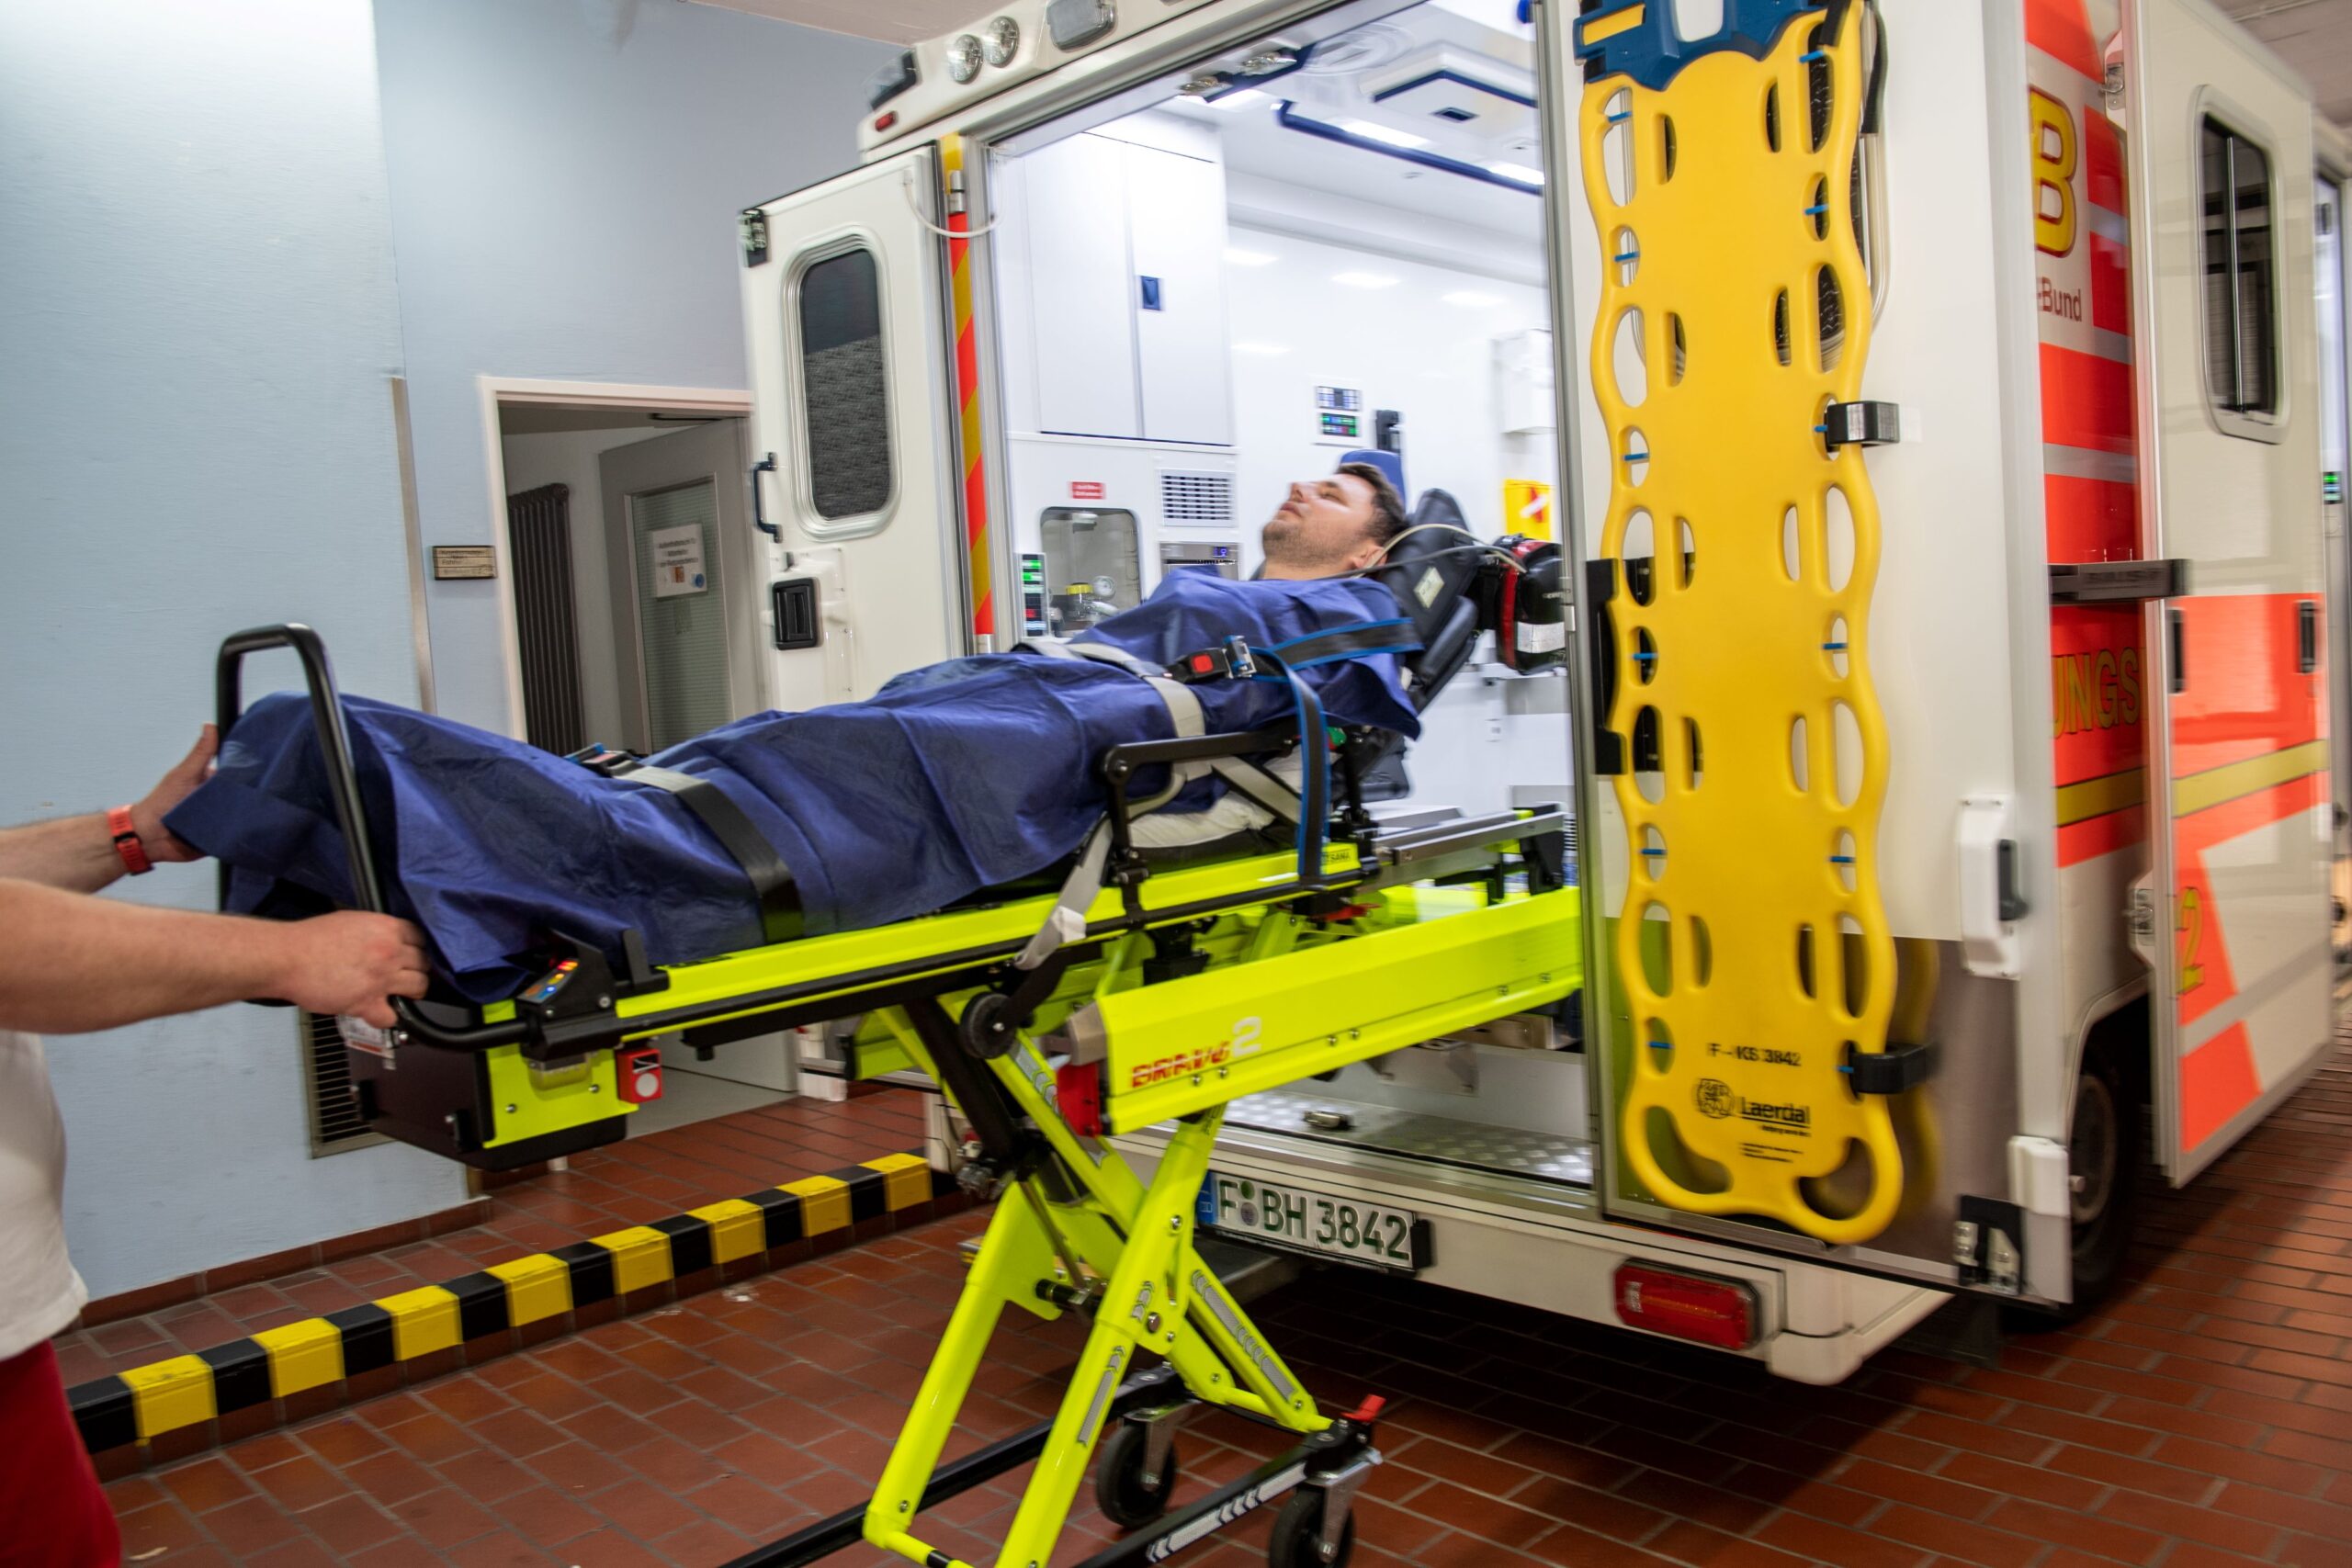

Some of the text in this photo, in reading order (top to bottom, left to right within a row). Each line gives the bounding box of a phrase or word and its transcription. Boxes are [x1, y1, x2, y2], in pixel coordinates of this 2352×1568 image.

[1232, 1015, 1262, 1057] 2
[1762, 1048, 1802, 1066] 3842
[1737, 1097, 1810, 1124] Laerdal
[1219, 1180, 1238, 1221] F
[1261, 1189, 1307, 1239] BH
[1316, 1199, 1410, 1261] 3842
